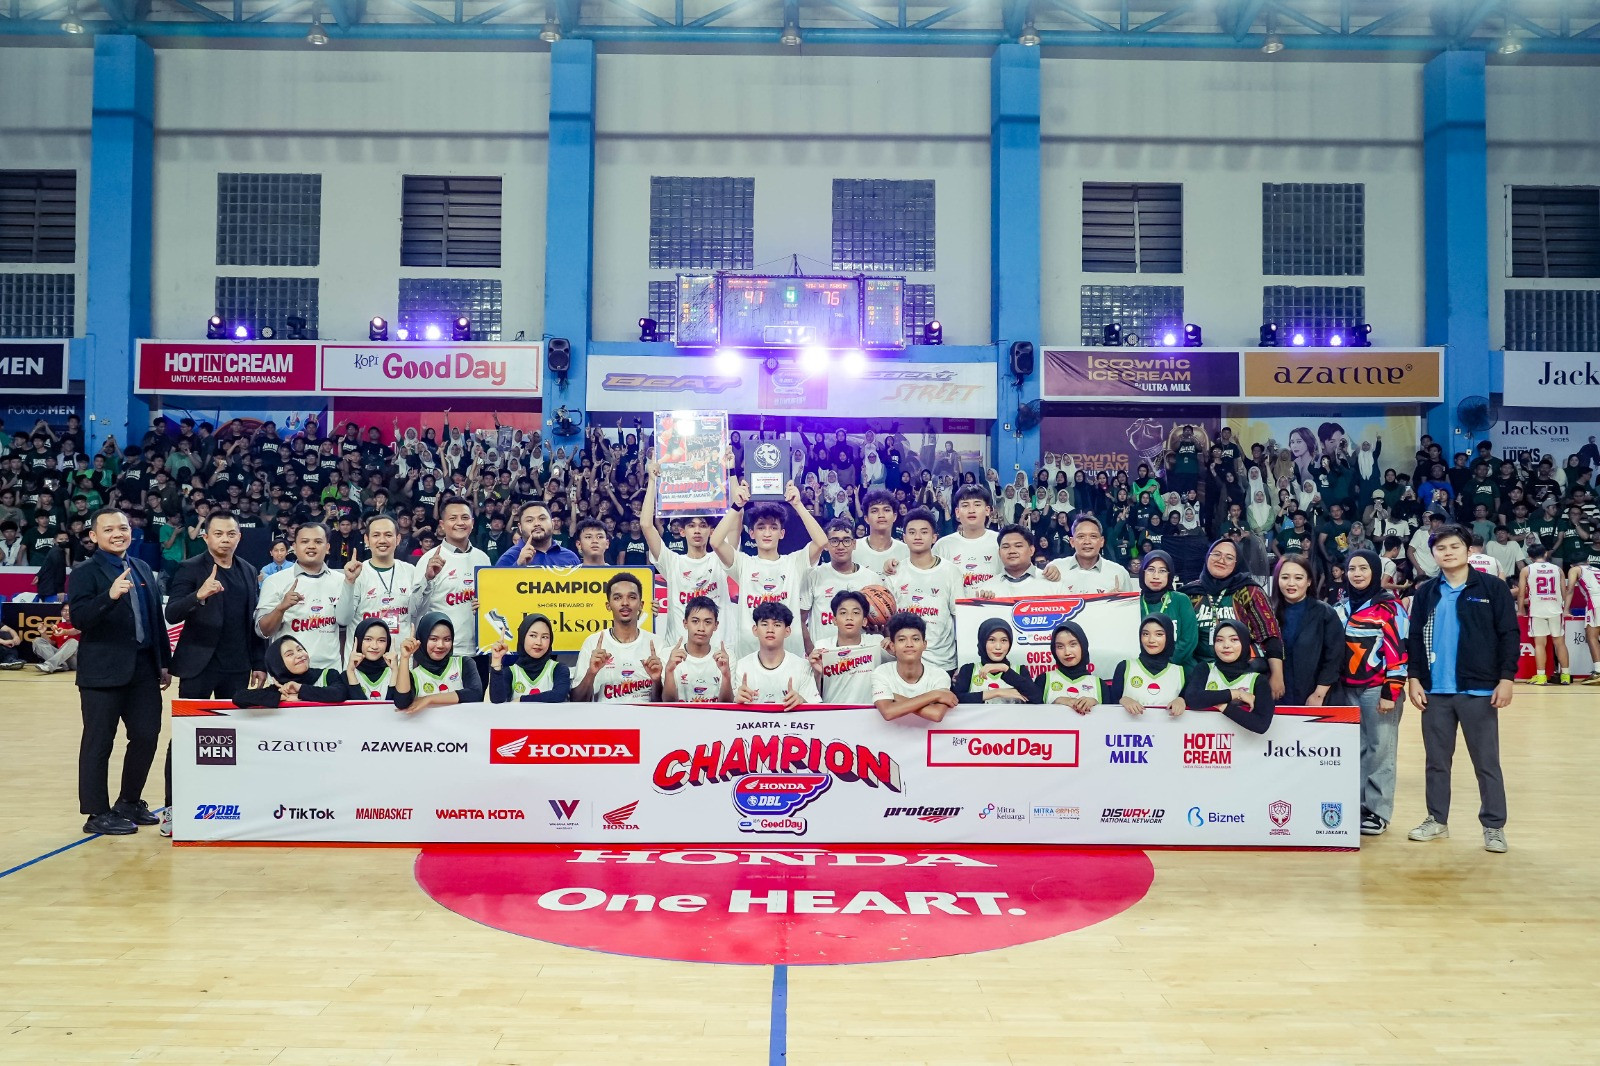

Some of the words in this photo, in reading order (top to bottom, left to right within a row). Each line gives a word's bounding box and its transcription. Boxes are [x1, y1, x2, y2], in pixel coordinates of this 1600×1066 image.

[786, 291, 796, 303] 4
[824, 291, 840, 306] 76
[382, 353, 450, 379] Good
[455, 353, 506, 386] Day
[171, 375, 195, 383] UNTUK
[198, 375, 222, 383] PEGAL
[1088, 371, 1118, 380] ICE
[1121, 371, 1191, 381] CREAM
[880, 383, 984, 401] STREET
[1142, 383, 1168, 392] ULTRA
[1169, 383, 1191, 392] MILK
[48, 406, 75, 415] MEN
[1501, 421, 1569, 435] Jackson
[1503, 448, 1540, 463] LOS
[516, 581, 609, 594] CHAMPIO
[1535, 577, 1556, 595] 21
[291, 616, 336, 632] CHAMPIO
[1031, 616, 1048, 625] DBL
[1027, 652, 1052, 664] GOES
[824, 655, 872, 677] CHAMPION
[736, 721, 780, 730] JAKARTA
[790, 721, 815, 730] EAST
[198, 735, 233, 744] POND'S
[1105, 734, 1153, 748] ULTRA
[199, 746, 233, 758] MEN
[361, 742, 468, 753] AZAWEAR.COM
[528, 744, 633, 758] HONDA
[968, 738, 1015, 756] Good
[1017, 738, 1053, 760] Day
[1263, 740, 1341, 757] Jackson
[1109, 751, 1148, 763] MILK
[1183, 750, 1231, 764] CREAM
[652, 735, 902, 794] CHAMPION
[758, 796, 781, 806] DBL
[289, 808, 335, 820] TikTok
[355, 808, 413, 820] MAINBASKET
[436, 809, 484, 820] WARTA
[488, 809, 525, 820] KOTA
[883, 806, 960, 818] proteam
[997, 813, 1025, 821] Keluarga
[1102, 808, 1165, 818] DISWAY.ID
[1208, 812, 1245, 823] Biznet
[761, 819, 784, 828] Good
[785, 819, 803, 830] Day
[566, 849, 998, 868] HONDA
[537, 887, 706, 912] One
[728, 889, 1027, 917] HEART.
